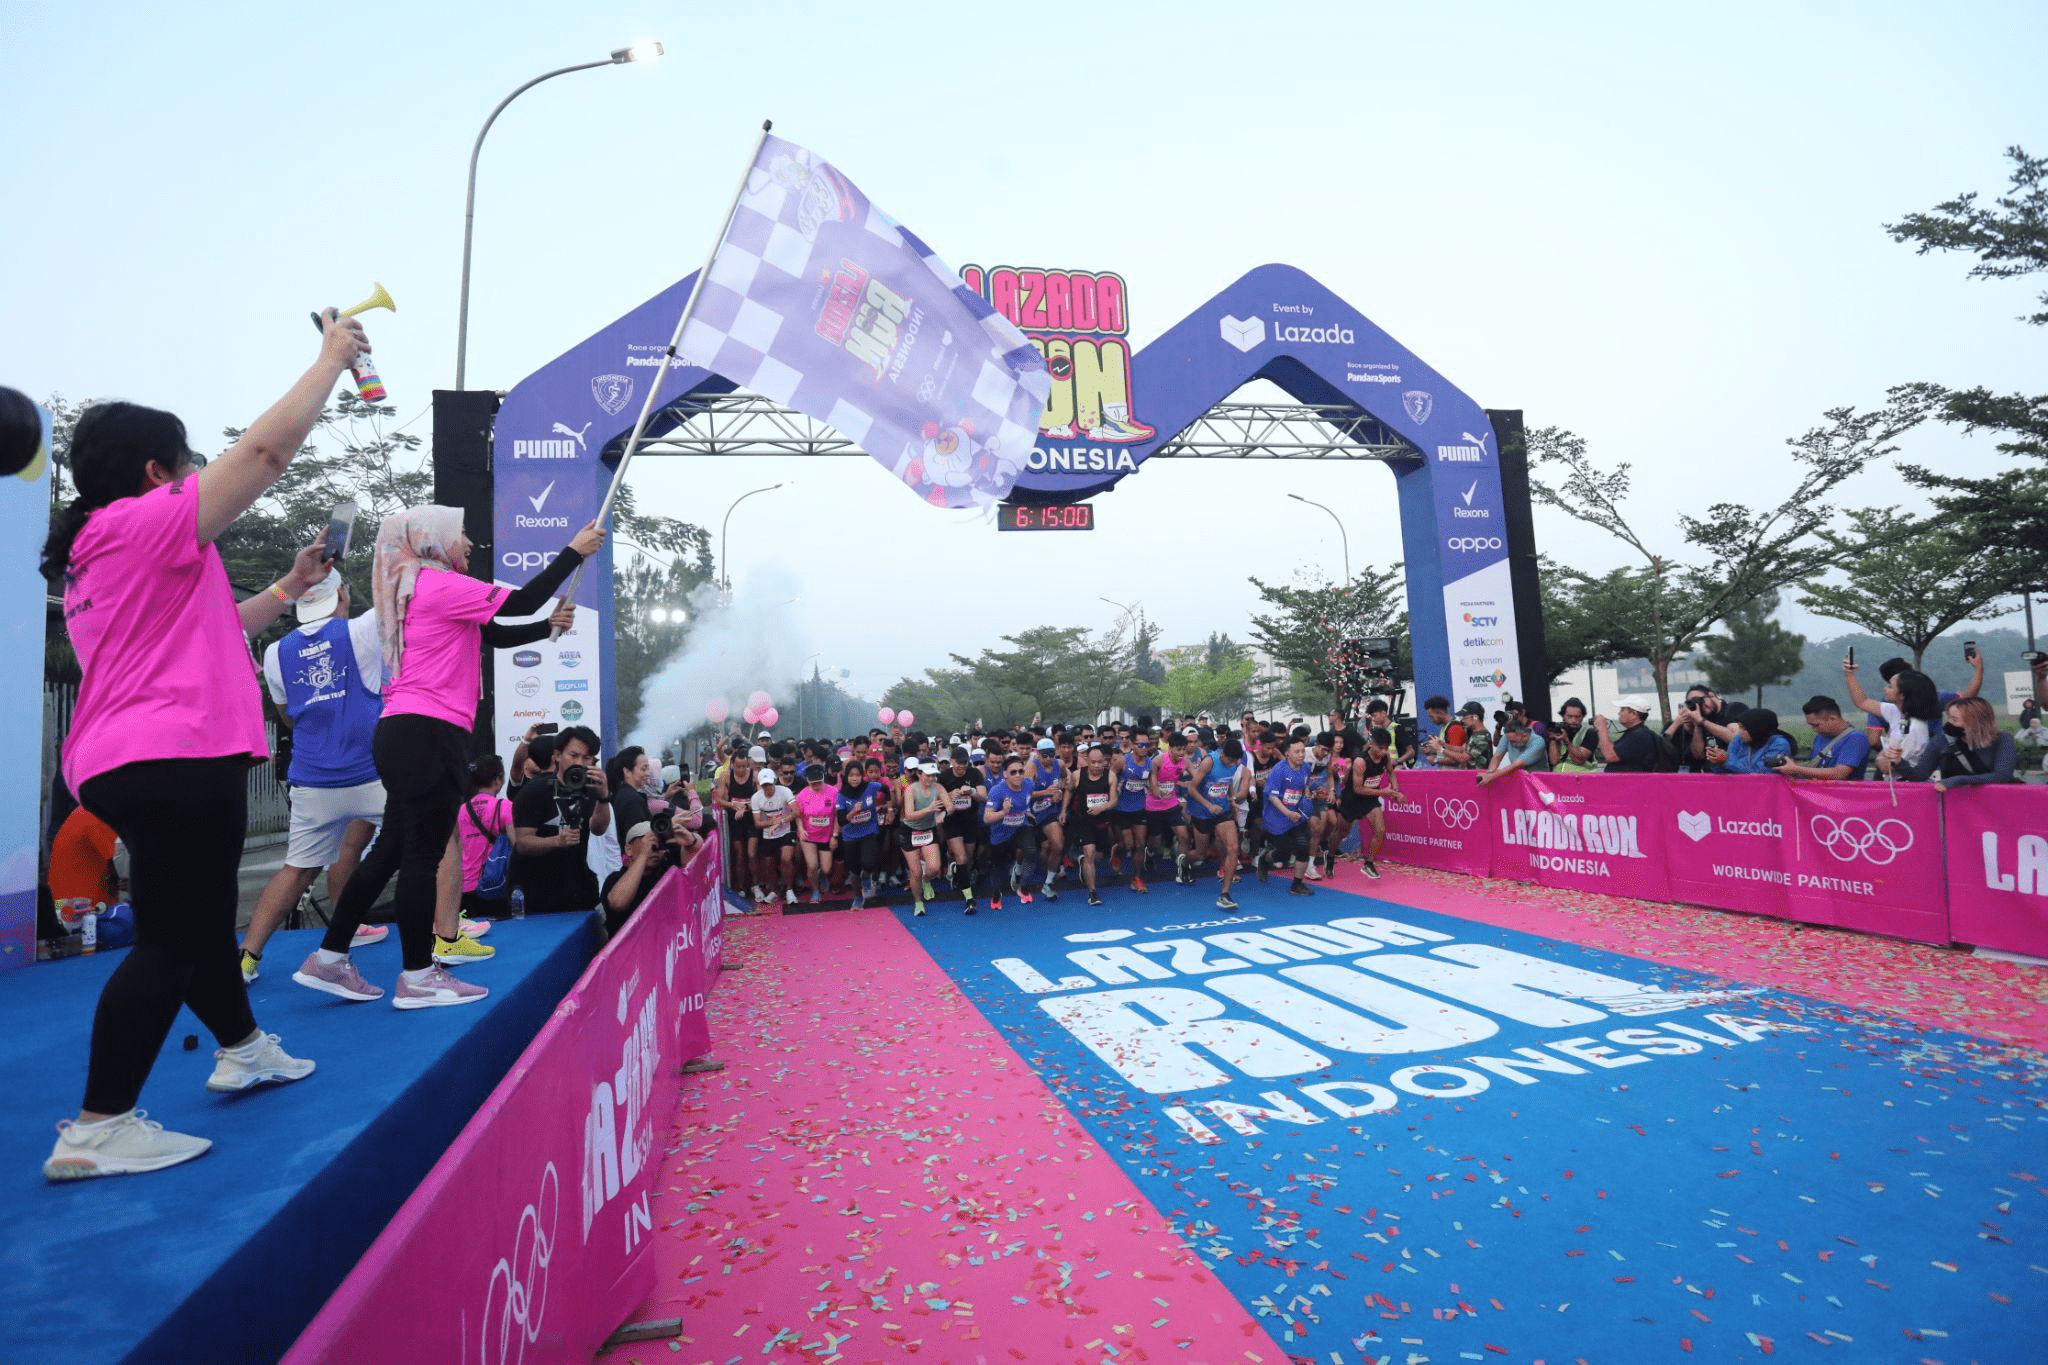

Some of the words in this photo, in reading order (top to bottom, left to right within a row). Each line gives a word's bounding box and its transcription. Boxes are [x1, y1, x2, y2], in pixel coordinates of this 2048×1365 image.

[1273, 303, 1299, 314] Event
[1302, 304, 1314, 316] by
[1274, 321, 1355, 345] Lazada
[513, 439, 576, 459] PUMA
[1436, 445, 1481, 462] PUMA
[1026, 448, 1137, 471] ONESIA
[515, 515, 568, 528] Rexona
[1453, 507, 1489, 518] Rexona
[1448, 537, 1502, 552] oppo
[502, 551, 560, 571] opp
[1471, 616, 1498, 627] SCTV
[1463, 637, 1504, 647] detikcom
[1469, 676, 1492, 684] MNC
[513, 710, 544, 718] Anlene
[1388, 799, 1422, 816] Lazada
[1557, 793, 1584, 804] Lazada
[1501, 808, 1584, 851] LAZADA
[1582, 813, 1647, 858] RUN
[1718, 816, 1783, 839] Lazada
[1385, 832, 1428, 846] WORLDWIDE
[1428, 836, 1463, 850] PARTNER
[1529, 853, 1611, 878] INDONESIA
[1712, 863, 1793, 887] WORLDWIDE
[1797, 873, 1876, 897] PARTNER
[1142, 914, 1267, 935] Lazada
[990, 916, 1457, 995] LAZADA
[1037, 942, 1612, 1095] RUN
[1162, 1011, 1778, 1145] INDONESIA
